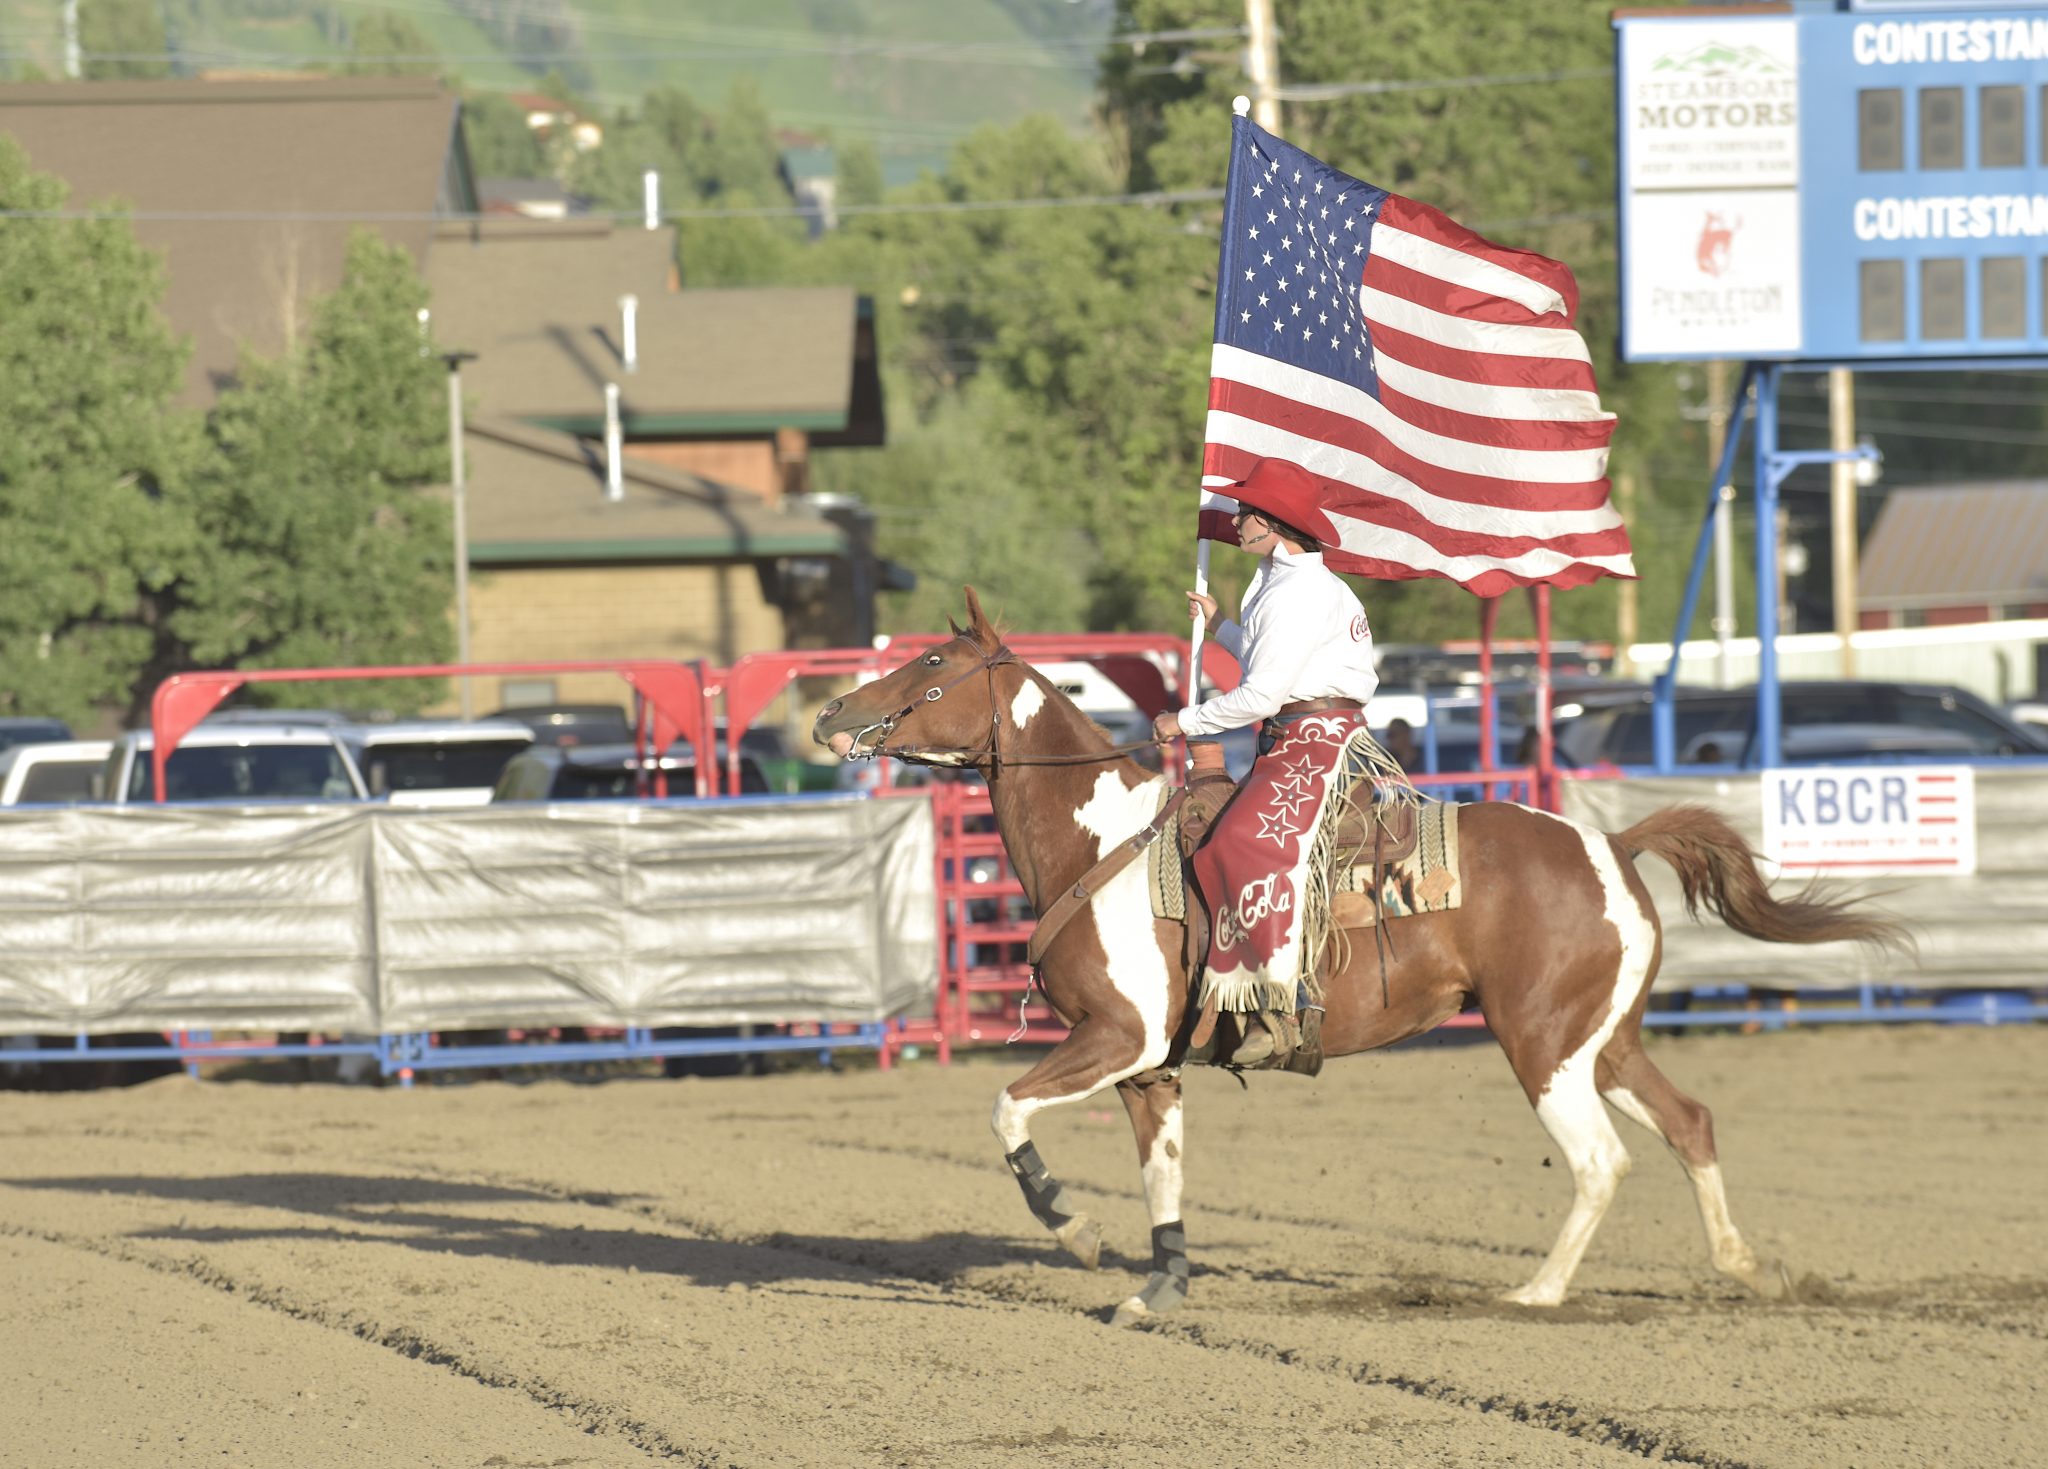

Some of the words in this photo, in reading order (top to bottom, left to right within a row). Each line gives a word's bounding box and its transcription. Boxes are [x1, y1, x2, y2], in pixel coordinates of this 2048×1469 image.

[1638, 78, 1795, 101] STEAMBOAT
[1638, 102, 1795, 129] MOTORS
[1779, 776, 1908, 826] KBCR
